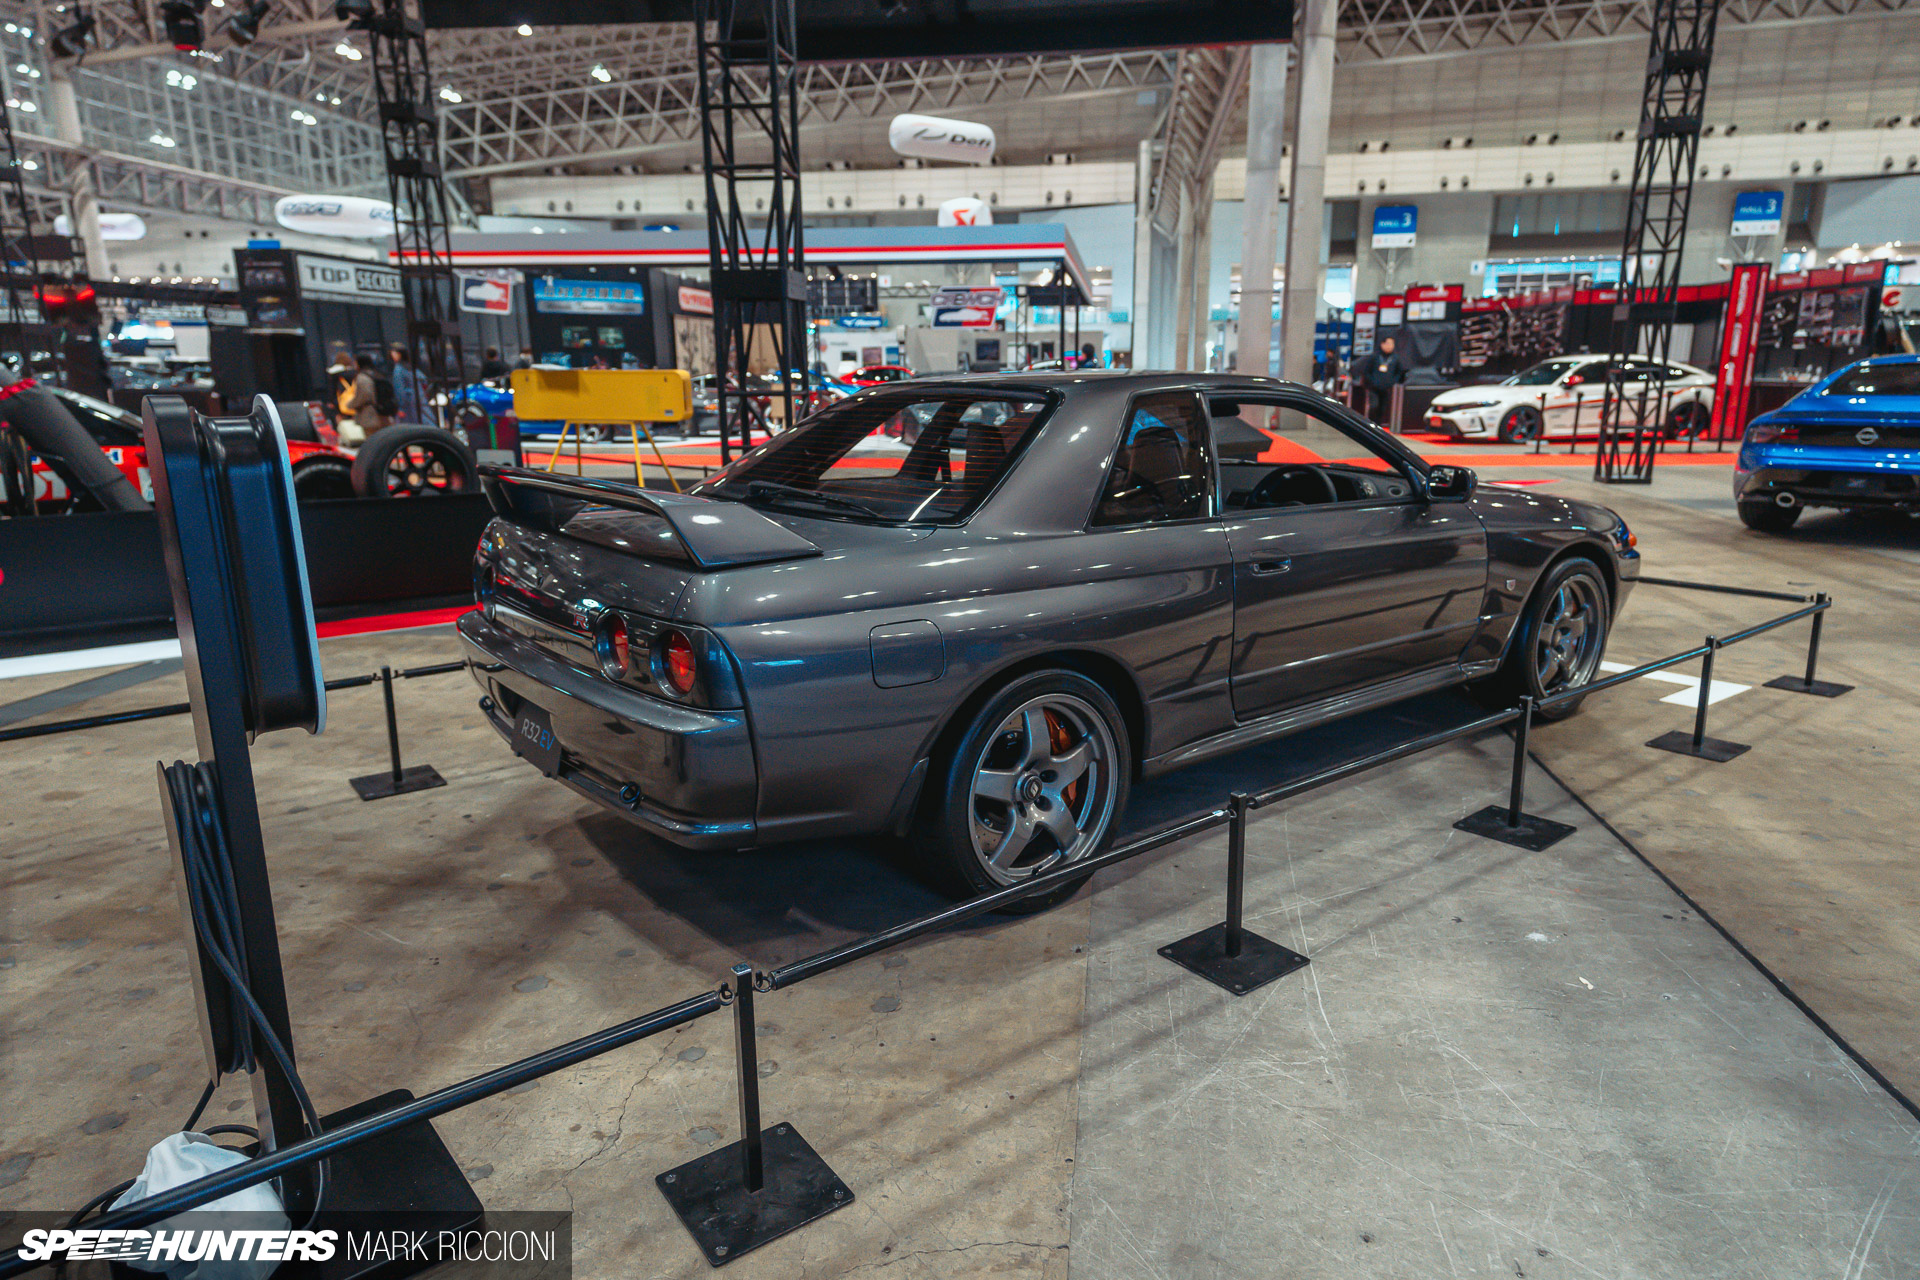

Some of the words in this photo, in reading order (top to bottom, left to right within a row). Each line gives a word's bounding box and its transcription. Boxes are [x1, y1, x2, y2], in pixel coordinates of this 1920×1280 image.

[305, 264, 350, 283] TOP
[356, 269, 402, 292] SECRET
[521, 718, 541, 744] R32
[539, 729, 556, 751] EV
